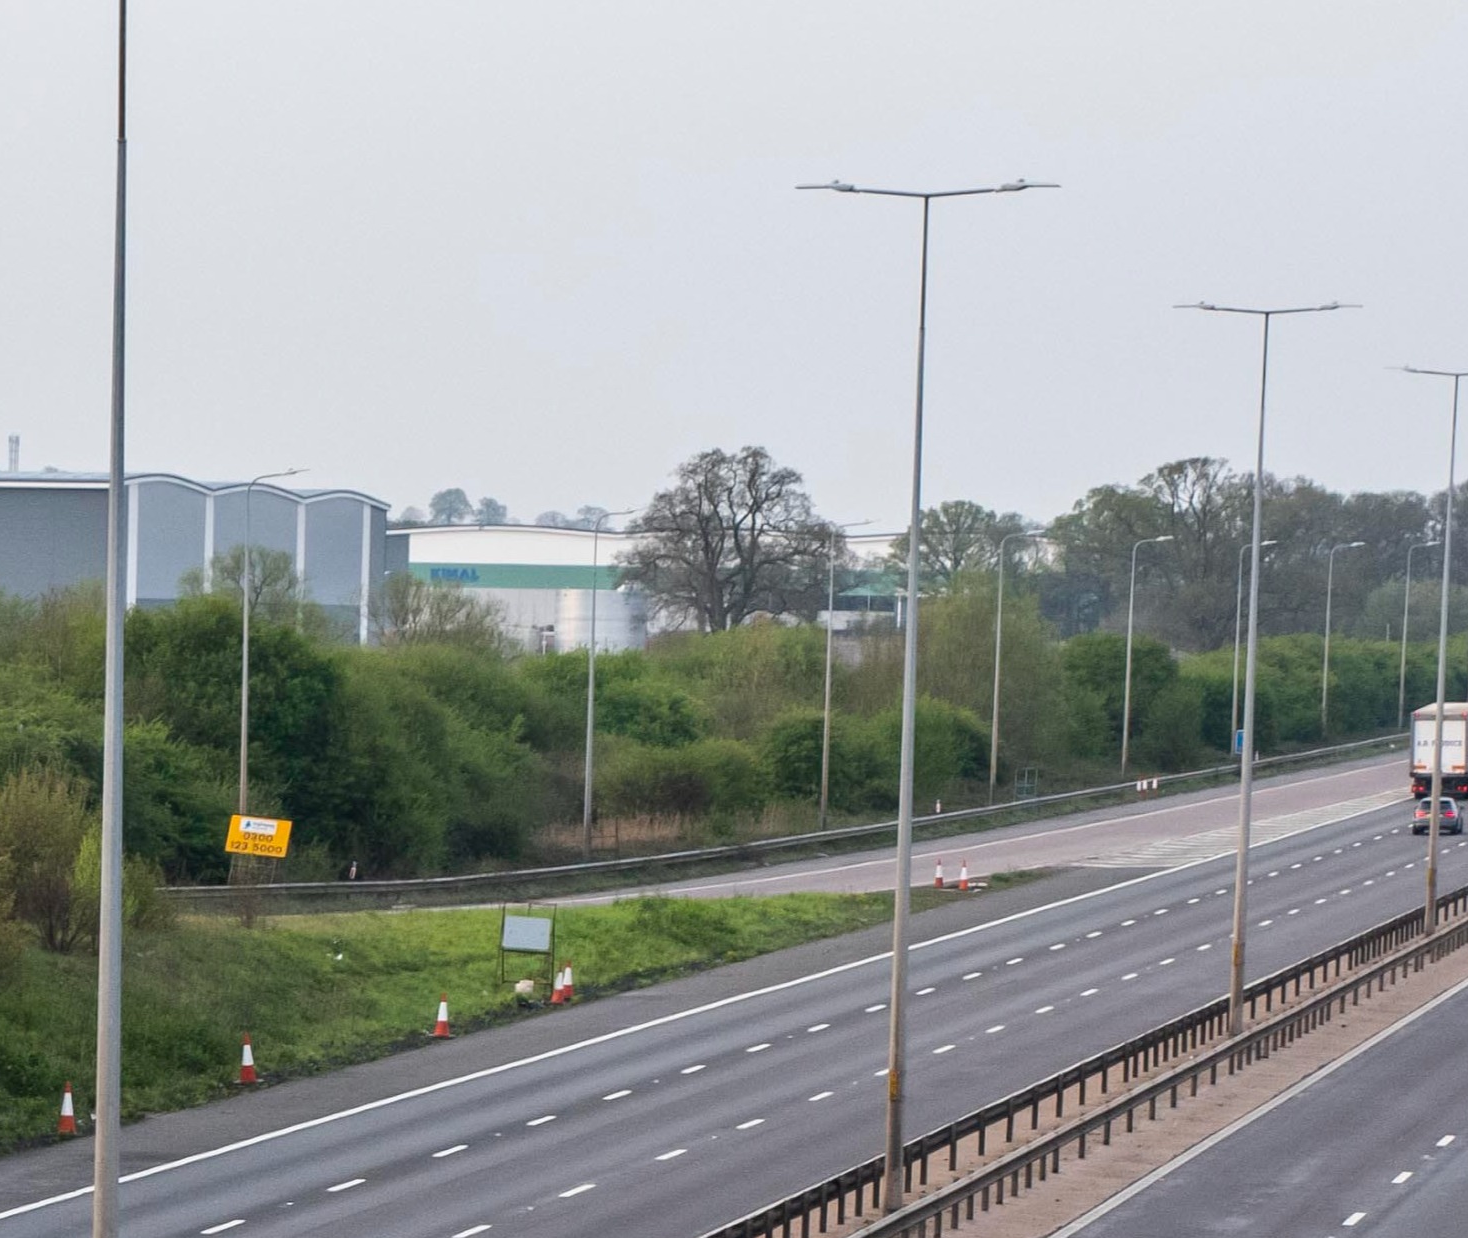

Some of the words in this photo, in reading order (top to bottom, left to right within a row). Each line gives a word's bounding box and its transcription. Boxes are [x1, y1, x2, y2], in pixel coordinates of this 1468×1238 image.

[243, 832, 273, 842] 0300
[231, 840, 248, 850] 123
[253, 843, 282, 854] 5000
